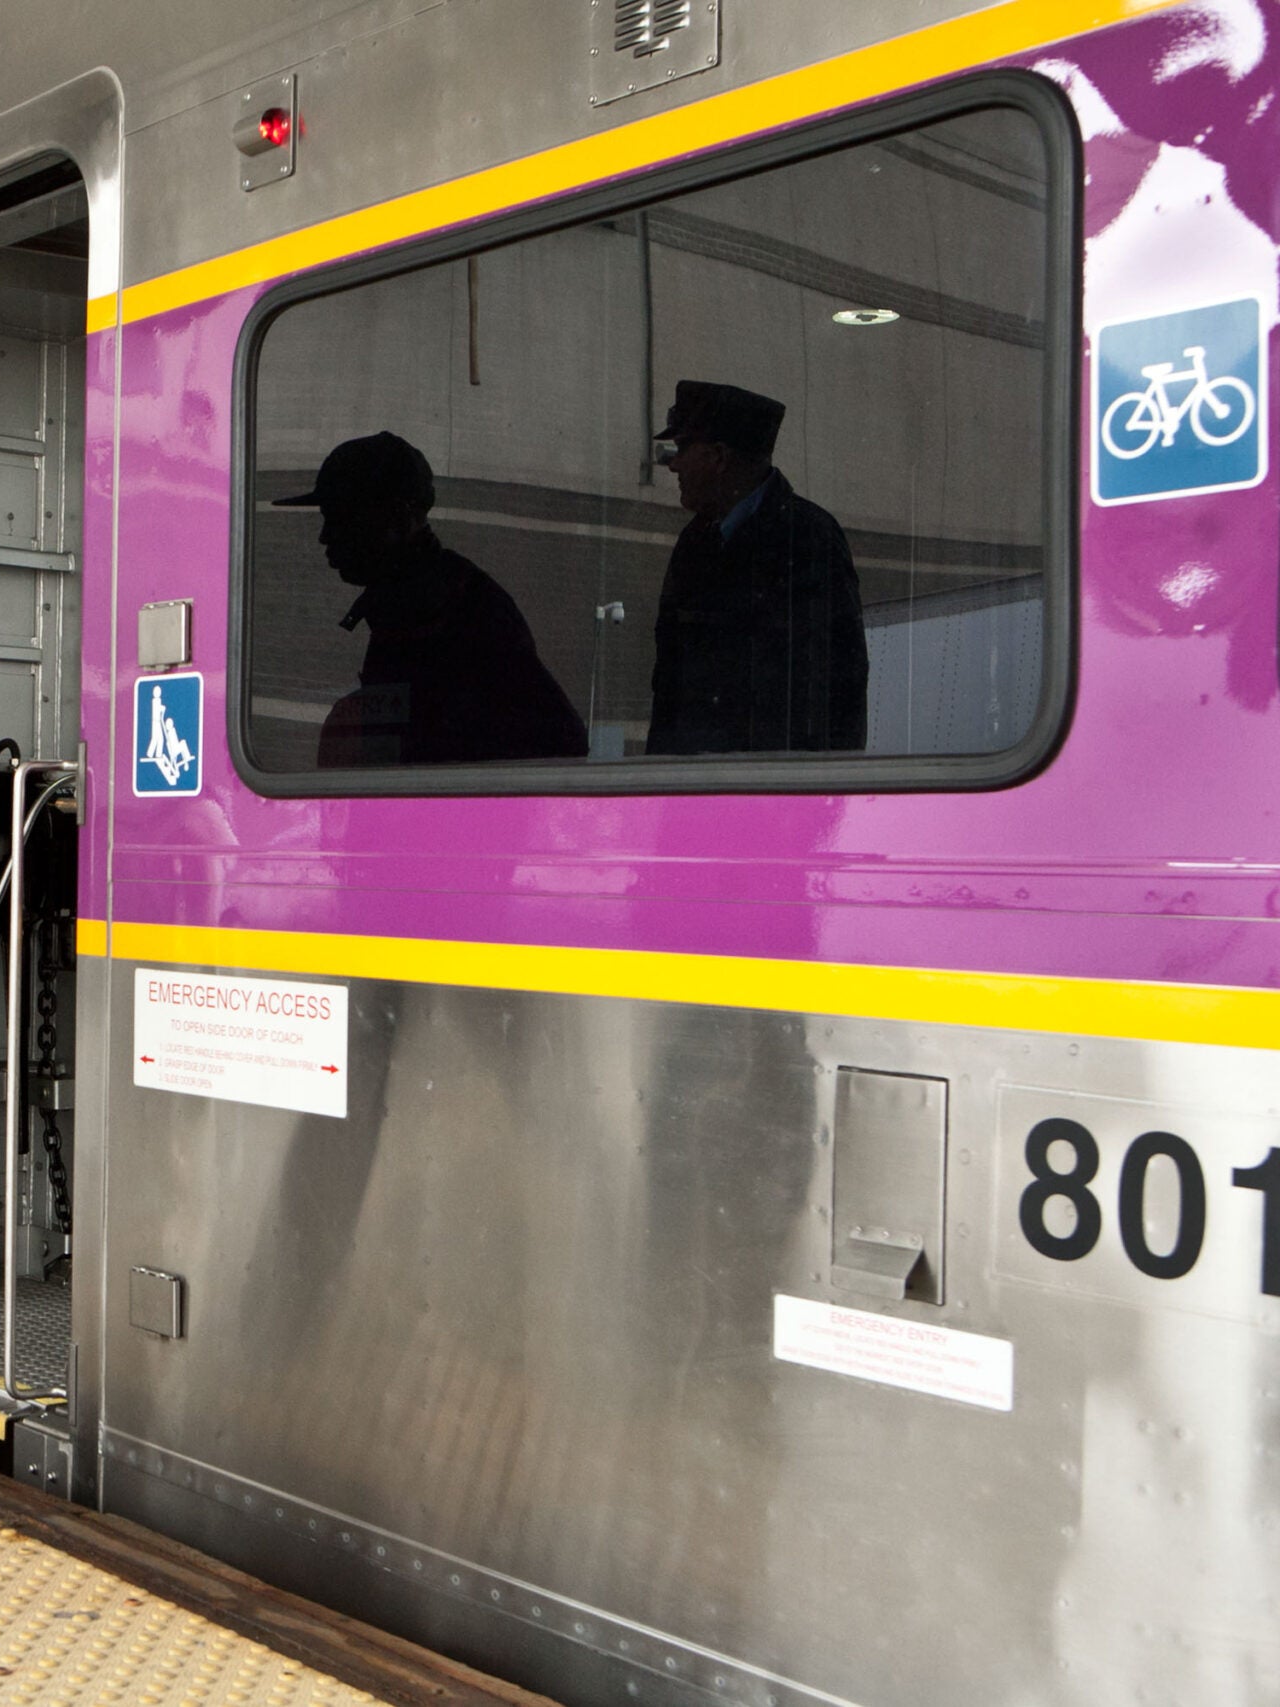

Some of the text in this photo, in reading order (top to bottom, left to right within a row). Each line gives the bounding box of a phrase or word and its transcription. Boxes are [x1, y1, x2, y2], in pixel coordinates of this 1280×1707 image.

[148, 980, 331, 1020] EMERGENCY ACCESS
[170, 1017, 304, 1046] TO OPEN SIDE DOOR OF COACH
[829, 1311, 949, 1345] EMERGENCY ENTRY
